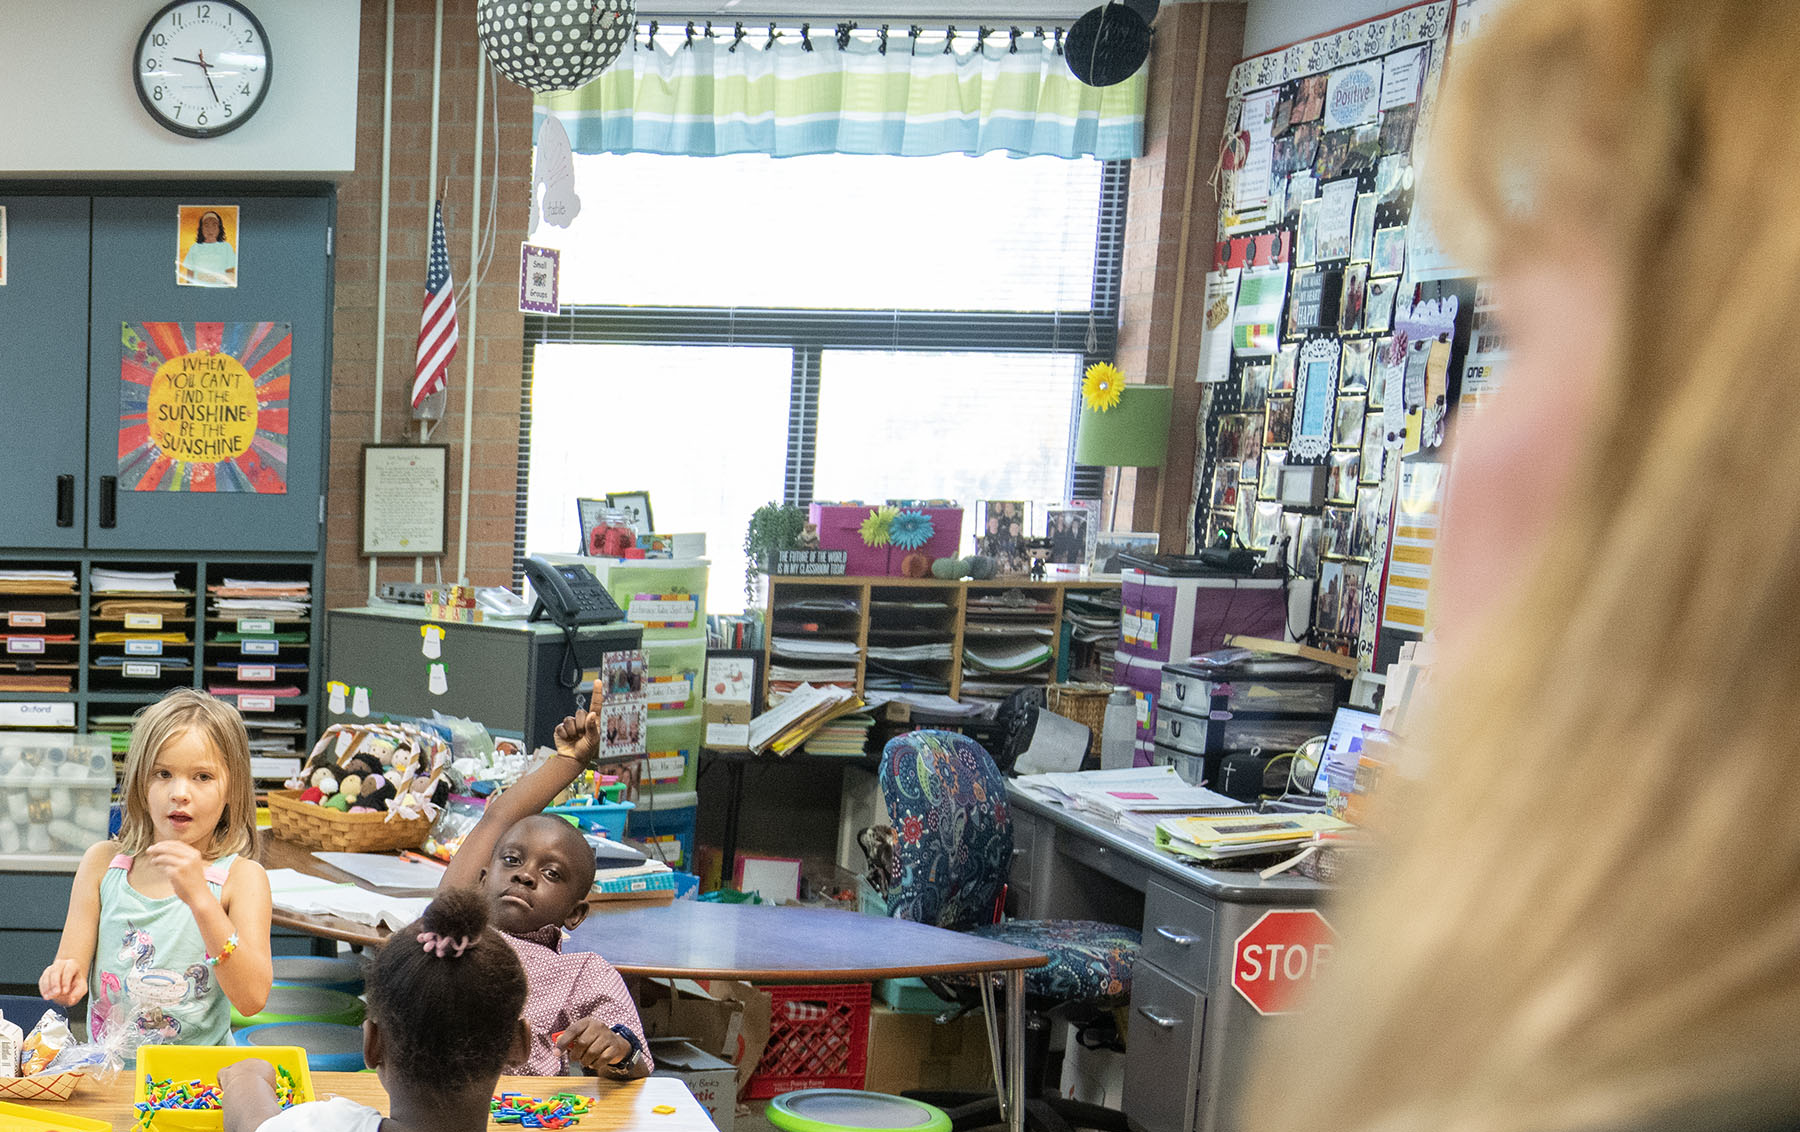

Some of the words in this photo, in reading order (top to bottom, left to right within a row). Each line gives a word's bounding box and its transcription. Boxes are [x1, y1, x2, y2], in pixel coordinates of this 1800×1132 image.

[197, 5, 210, 18] 12
[172, 13, 181, 26] 11
[152, 33, 165, 47] 10
[245, 30, 253, 43] 2
[146, 58, 157, 72] 9
[153, 85, 163, 101] 8
[241, 83, 250, 97] 4
[1335, 86, 1370, 107] Positive
[173, 106, 181, 119] 7
[197, 111, 208, 125] 6
[224, 104, 232, 118] 5
[533, 261, 547, 269] Small
[530, 289, 548, 299] Groups
[183, 358, 226, 371] WHEN
[166, 373, 196, 389] YOU
[201, 373, 242, 388] CAN'T
[175, 390, 203, 403] FIND
[208, 390, 229, 402] THE
[158, 404, 247, 422] SUNSHINE
[180, 421, 195, 437] BE
[202, 423, 225, 437] THE
[162, 433, 242, 455] SUNSHINE
[21, 705, 52, 714] Oxford
